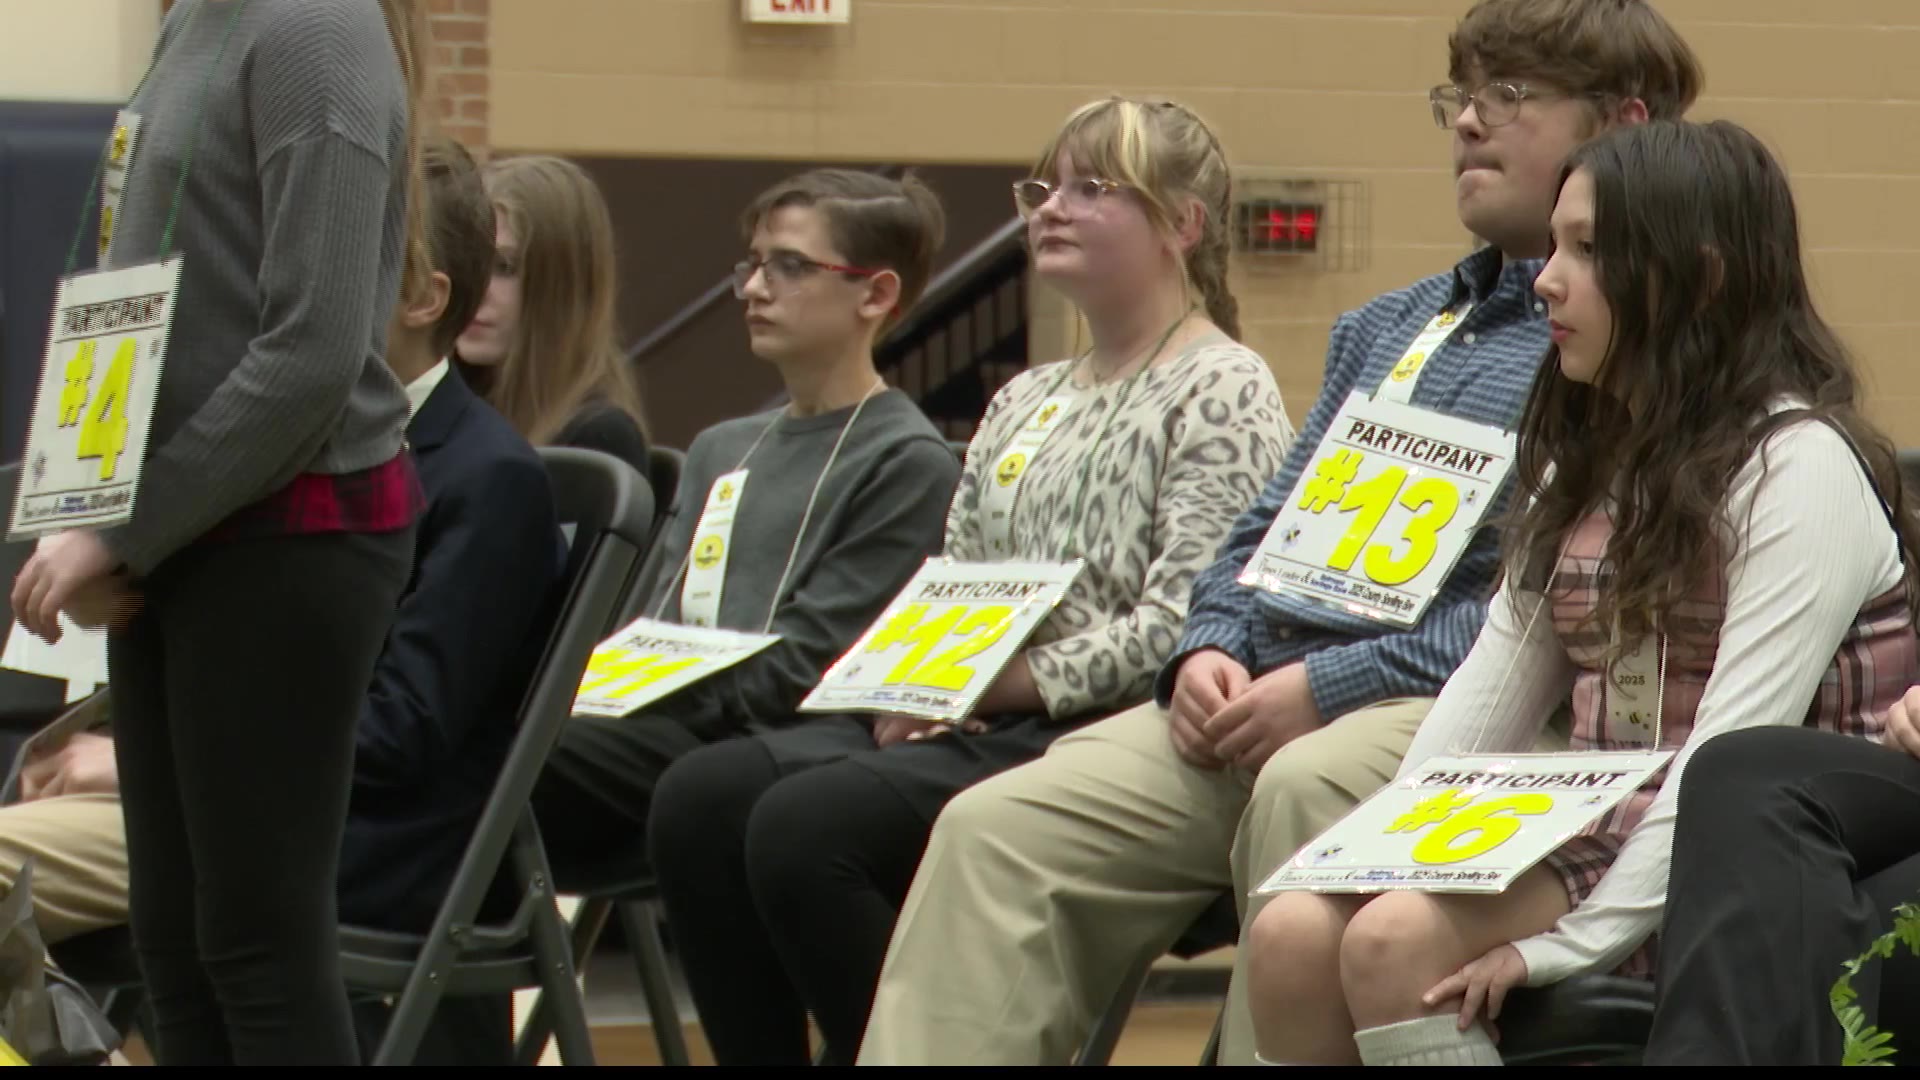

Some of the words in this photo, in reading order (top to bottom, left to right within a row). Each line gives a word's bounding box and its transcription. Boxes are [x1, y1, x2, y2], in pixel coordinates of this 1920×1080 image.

[62, 295, 165, 337] PARTICIPANT
[58, 337, 137, 481] #4
[1346, 421, 1494, 475] PARTICIPANT
[1298, 448, 1460, 586] #13
[919, 581, 1049, 599] PARTICIPANT
[864, 602, 1015, 692] #12
[1618, 675, 1646, 686] 2025
[1420, 771, 1627, 788] PARTICIPANT
[1383, 787, 1555, 866] #6
